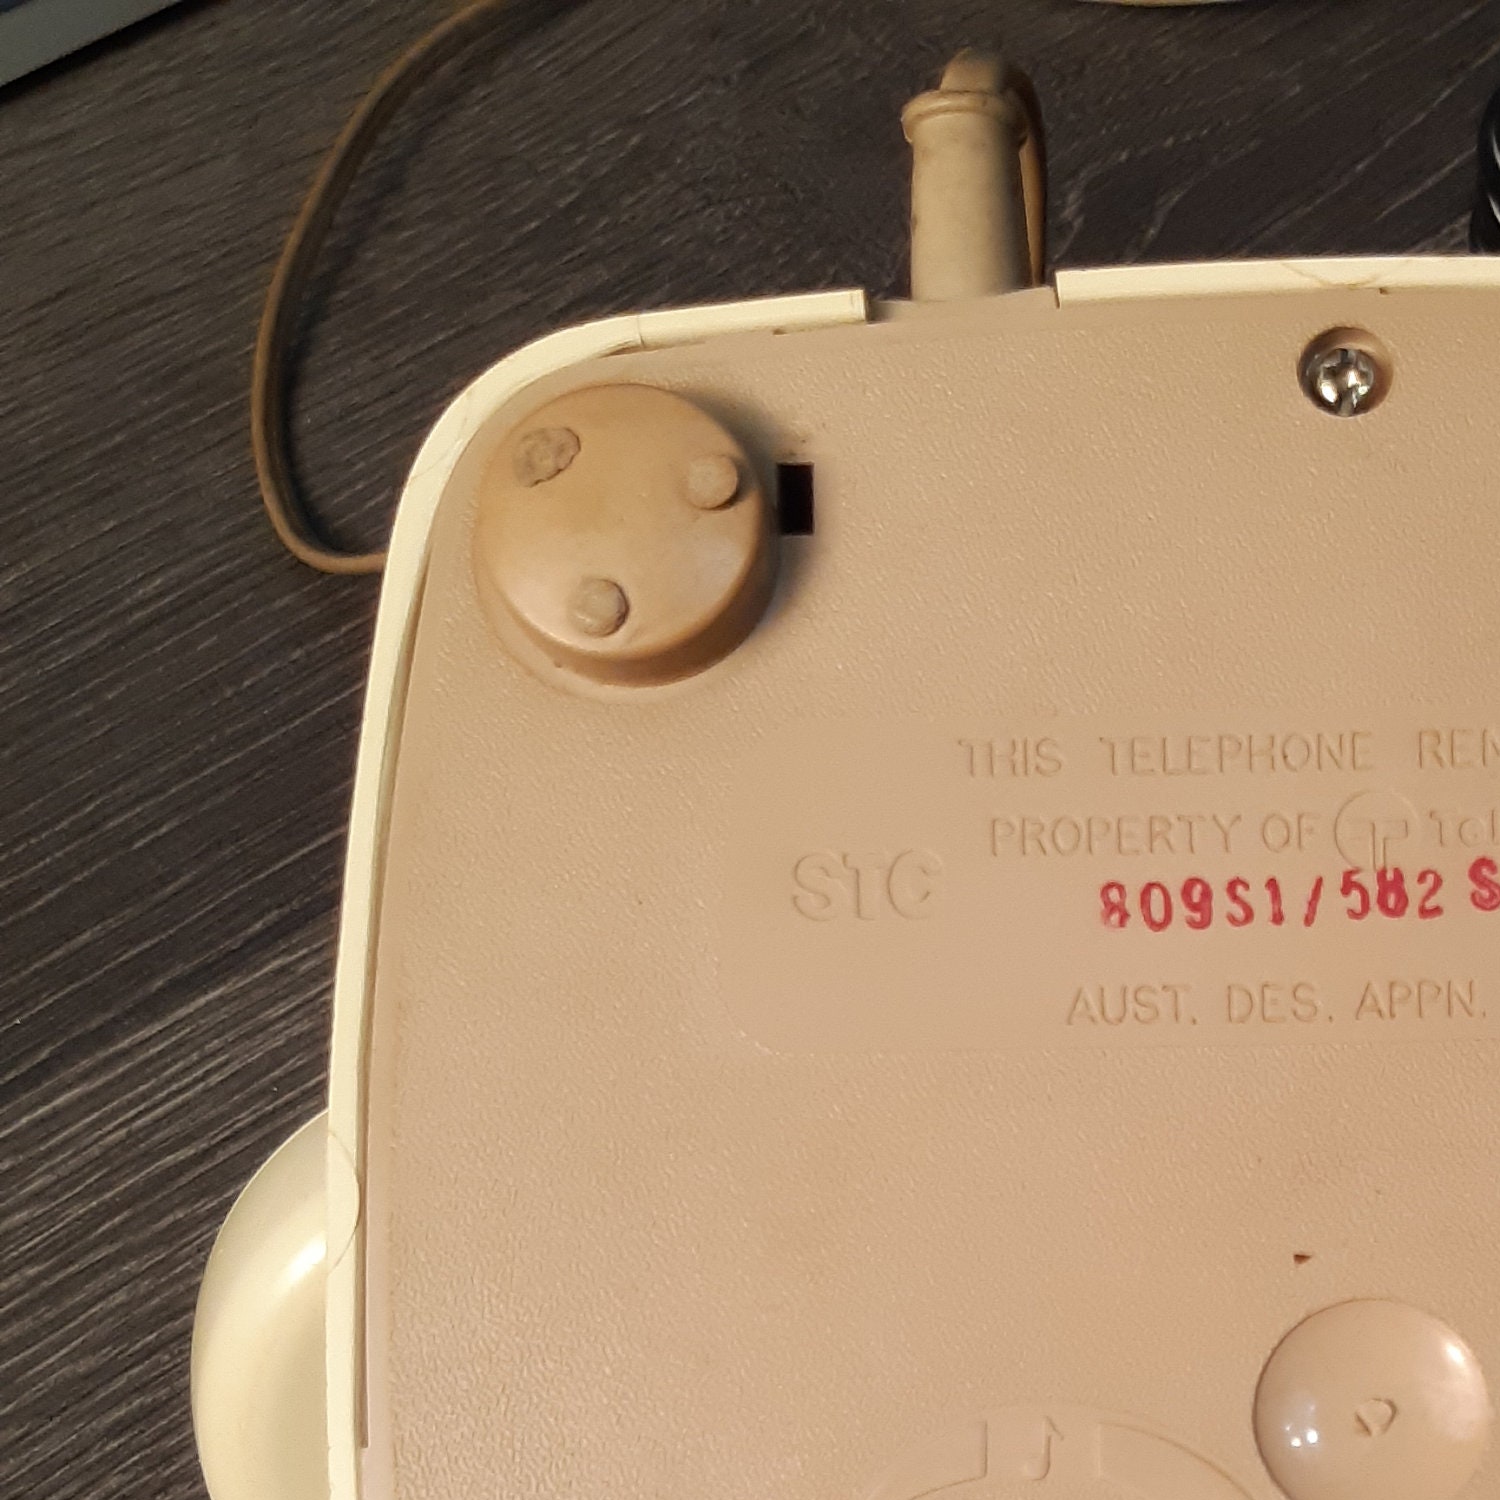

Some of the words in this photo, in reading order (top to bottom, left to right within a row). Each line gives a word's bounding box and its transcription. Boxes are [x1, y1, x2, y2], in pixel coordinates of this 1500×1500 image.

[956, 734, 1064, 779] THIS
[1099, 729, 1374, 777] TELEPHONE
[990, 813, 1242, 858] PROPERTY
[1261, 808, 1322, 854] OF
[790, 848, 942, 922] STC
[1065, 982, 1199, 1027] AUST.
[1225, 980, 1334, 1026] DES.
[1354, 976, 1489, 1022] APPN.
